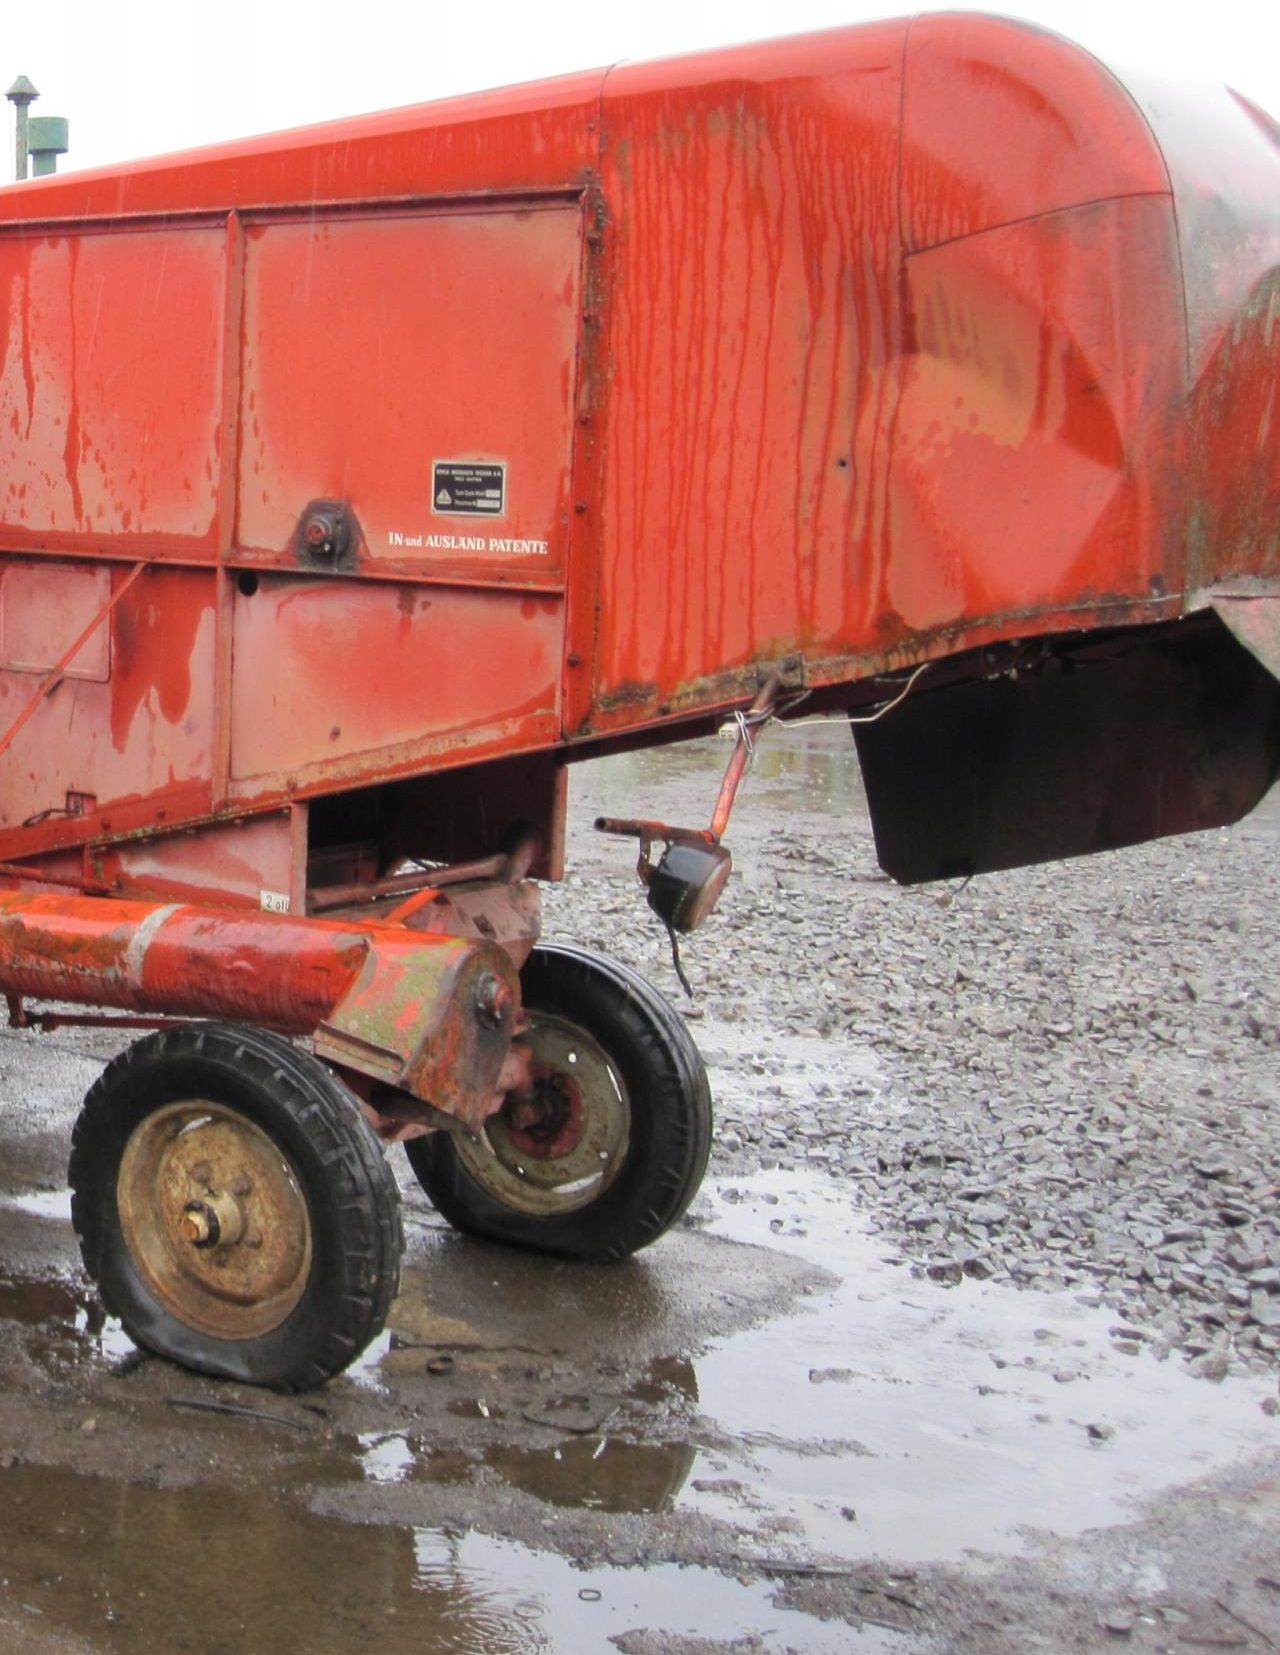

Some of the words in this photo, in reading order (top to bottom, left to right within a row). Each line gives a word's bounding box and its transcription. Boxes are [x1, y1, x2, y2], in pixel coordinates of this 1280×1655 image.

[425, 535, 486, 550] AUSLAND
[488, 538, 549, 554] PATENTE
[266, 894, 273, 909] 2
